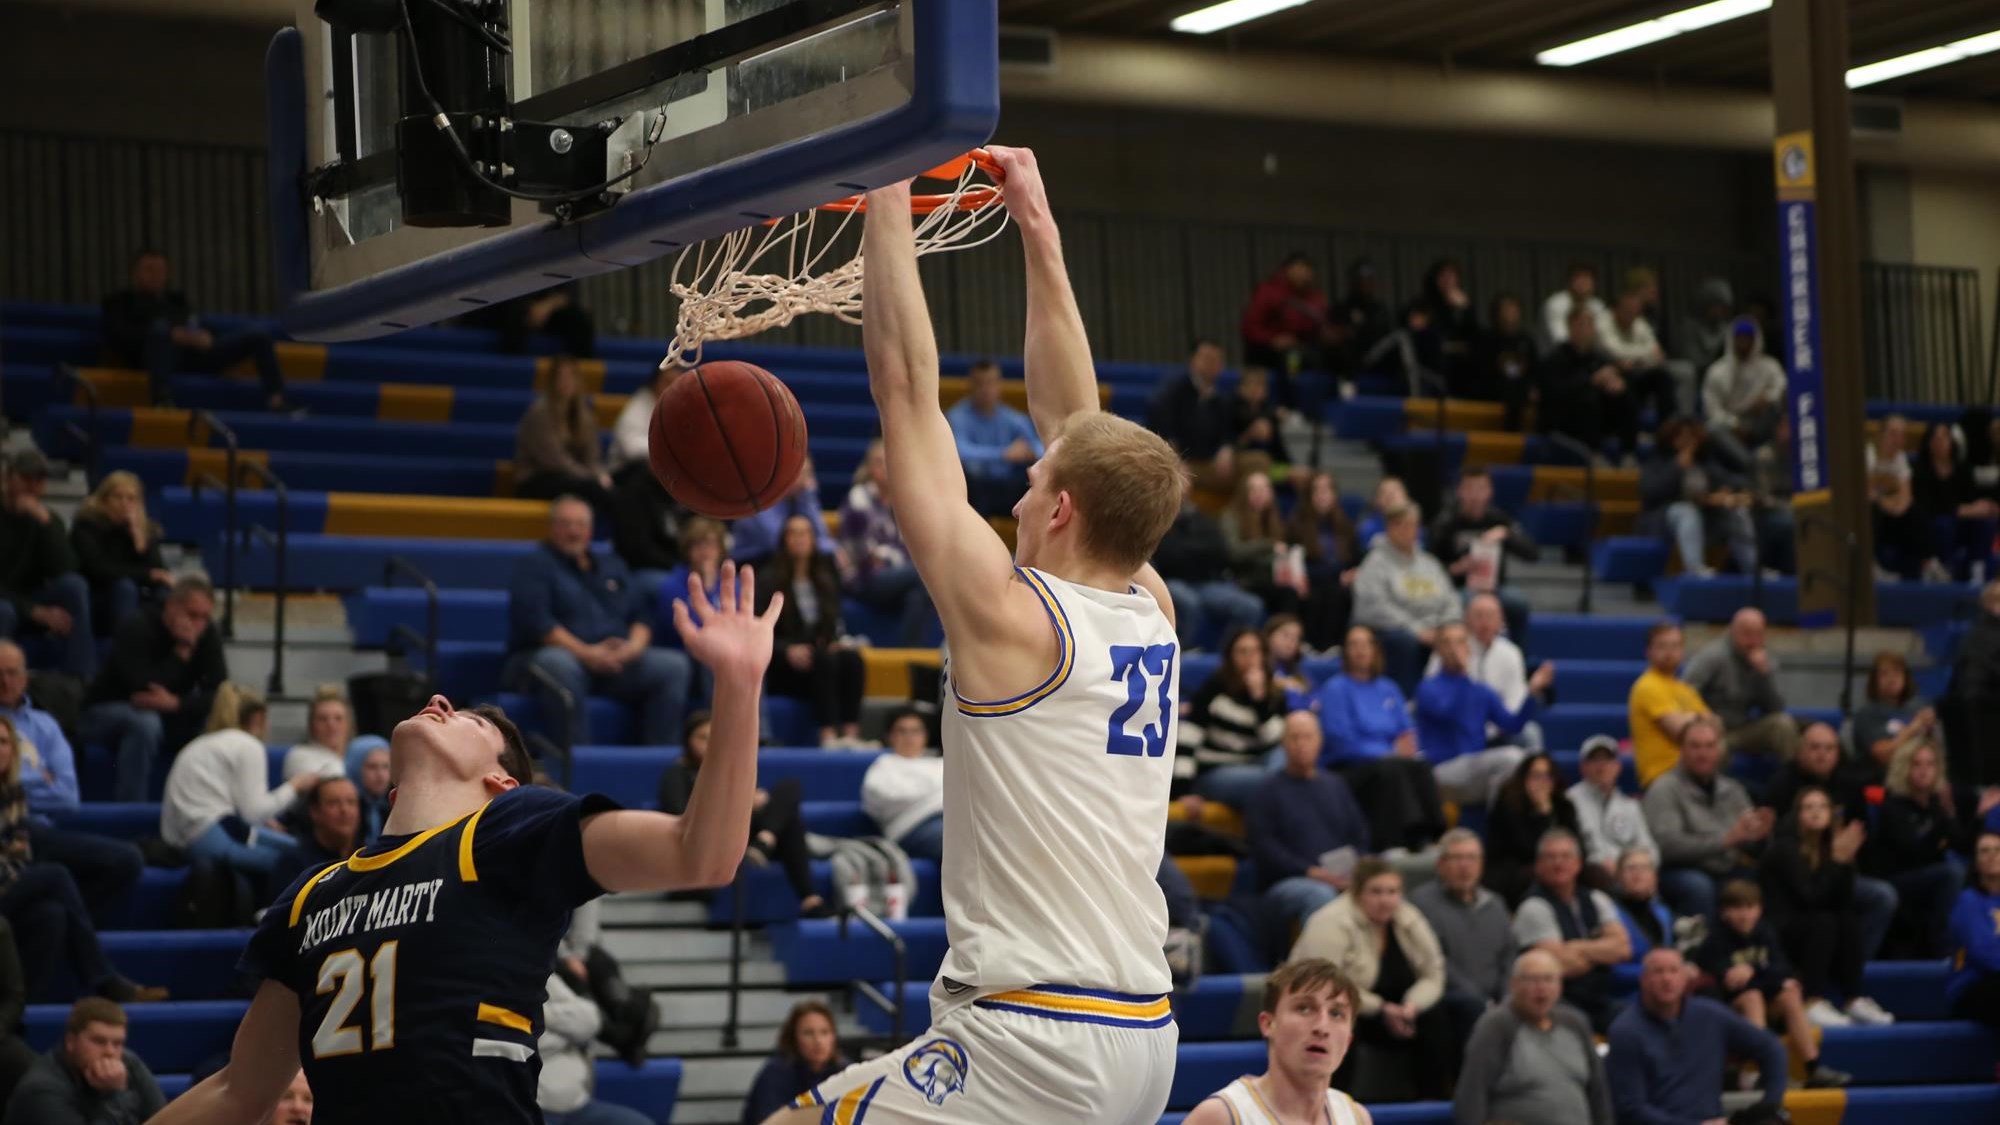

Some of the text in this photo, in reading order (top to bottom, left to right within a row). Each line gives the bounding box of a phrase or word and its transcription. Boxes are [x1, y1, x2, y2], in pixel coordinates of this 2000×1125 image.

[1106, 642, 1176, 757] 23
[298, 878, 444, 954] MOUNT MARTY
[311, 939, 399, 1060] 21
